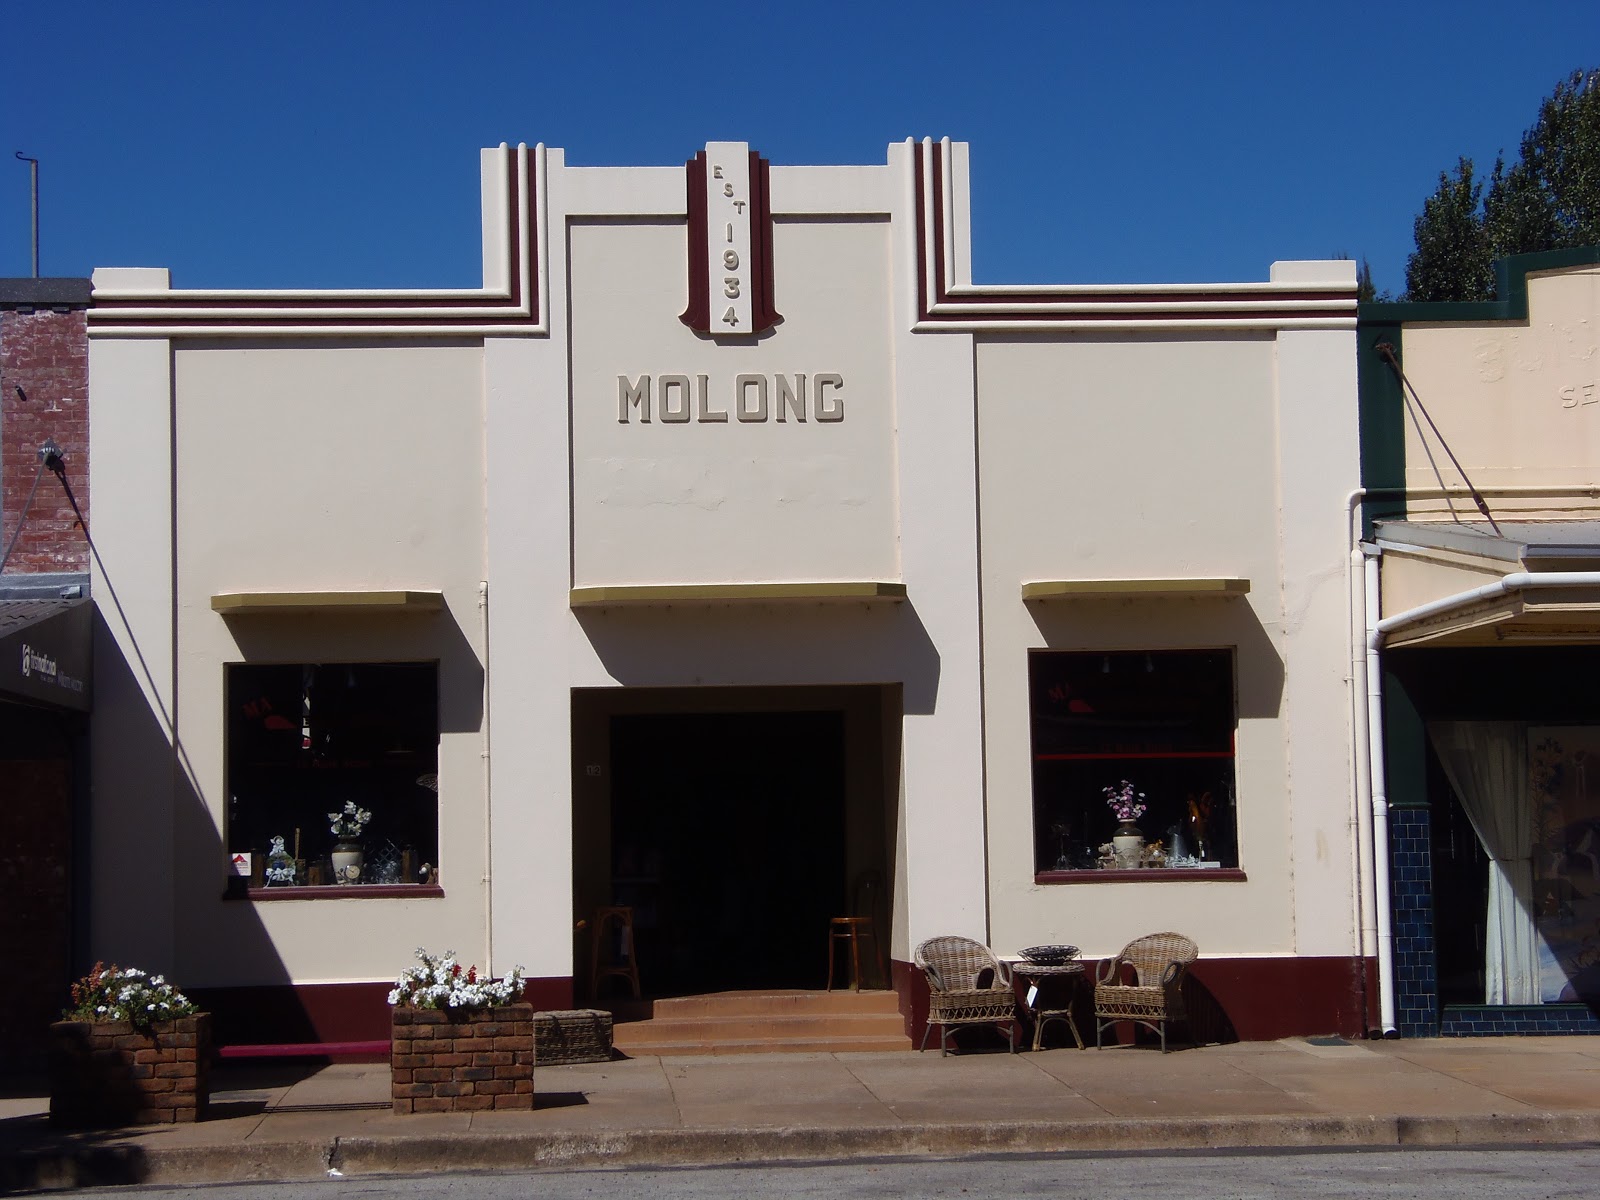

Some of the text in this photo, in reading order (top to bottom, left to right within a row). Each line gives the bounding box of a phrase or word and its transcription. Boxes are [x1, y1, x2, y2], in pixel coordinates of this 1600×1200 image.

[713, 165, 746, 327] EST 1934
[617, 373, 844, 424] MOLONG
